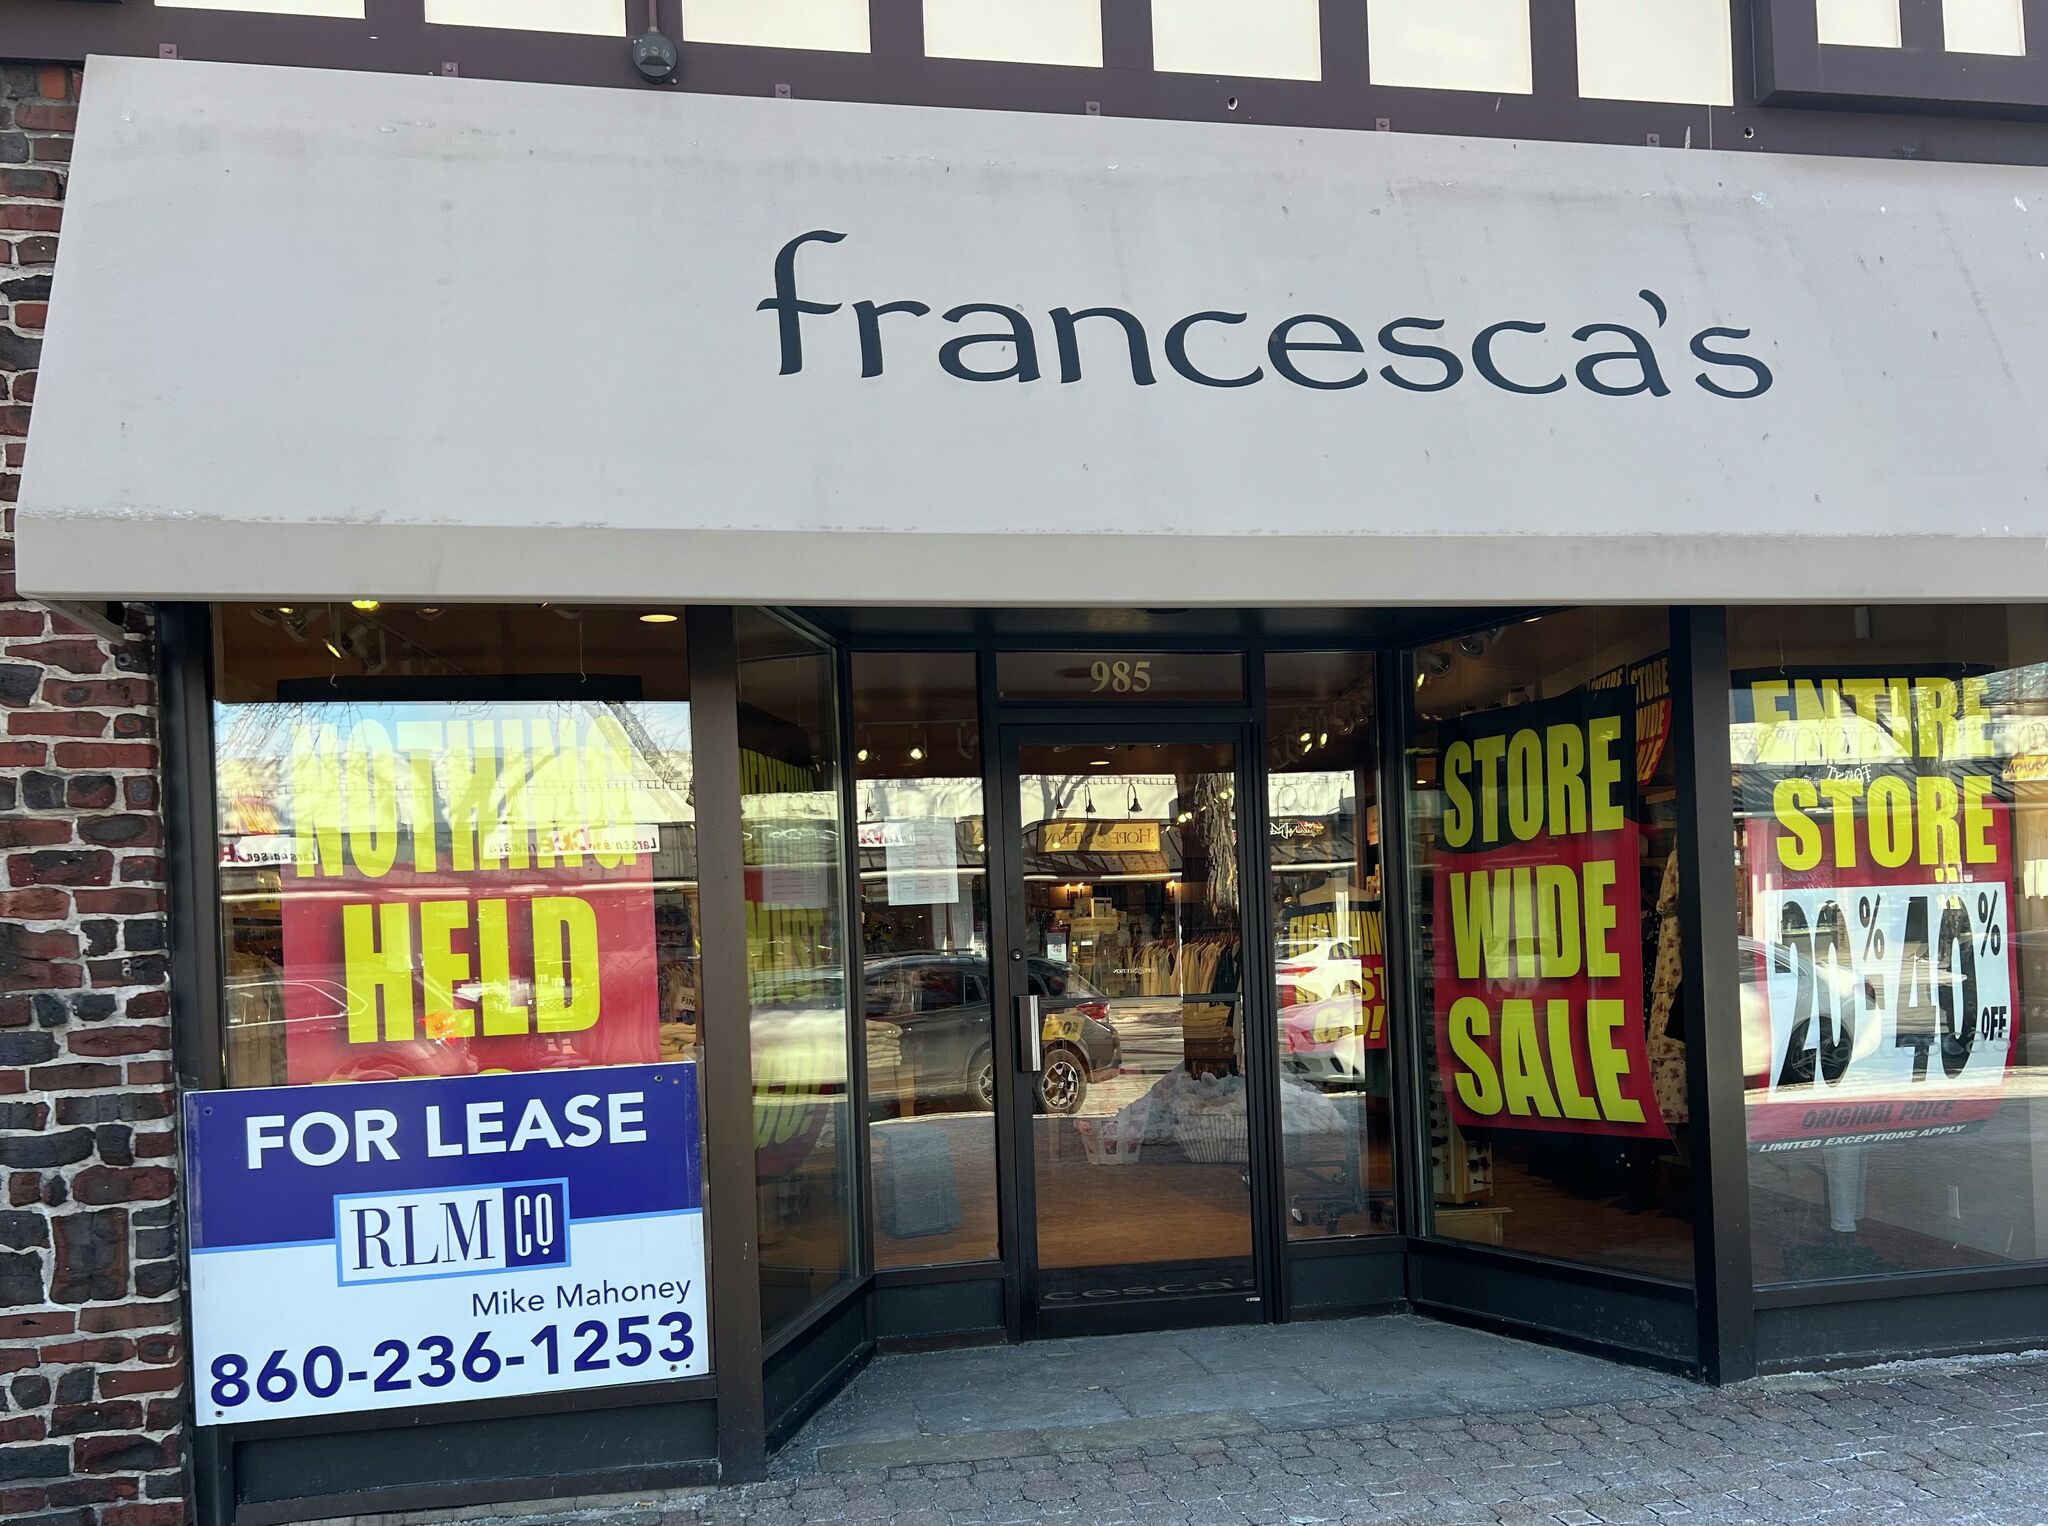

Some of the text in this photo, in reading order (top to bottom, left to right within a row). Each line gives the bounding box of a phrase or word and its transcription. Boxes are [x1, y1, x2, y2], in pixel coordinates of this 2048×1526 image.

[755, 229, 1774, 399] francesca's
[1091, 661, 1151, 693] 985
[1751, 677, 1996, 759] ENTIRE
[290, 715, 638, 878] NOTHING
[1443, 715, 1625, 849] STORE
[1773, 775, 1998, 871] STORE
[1449, 860, 1622, 980] WIDE
[342, 896, 602, 1044] HELD
[1447, 997, 1647, 1123] SALE
[1981, 1006, 2006, 1041] OFF
[246, 1091, 648, 1170] FOR LEASE
[1758, 1124, 1968, 1153] LIMITED EXCEPTIONS APPLY
[1802, 1099, 1956, 1131] ORIGINAL PRICE
[349, 1198, 496, 1271] RLM
[472, 1279, 692, 1318] Mike Mahoney
[209, 1310, 696, 1409] 860-236-1253
